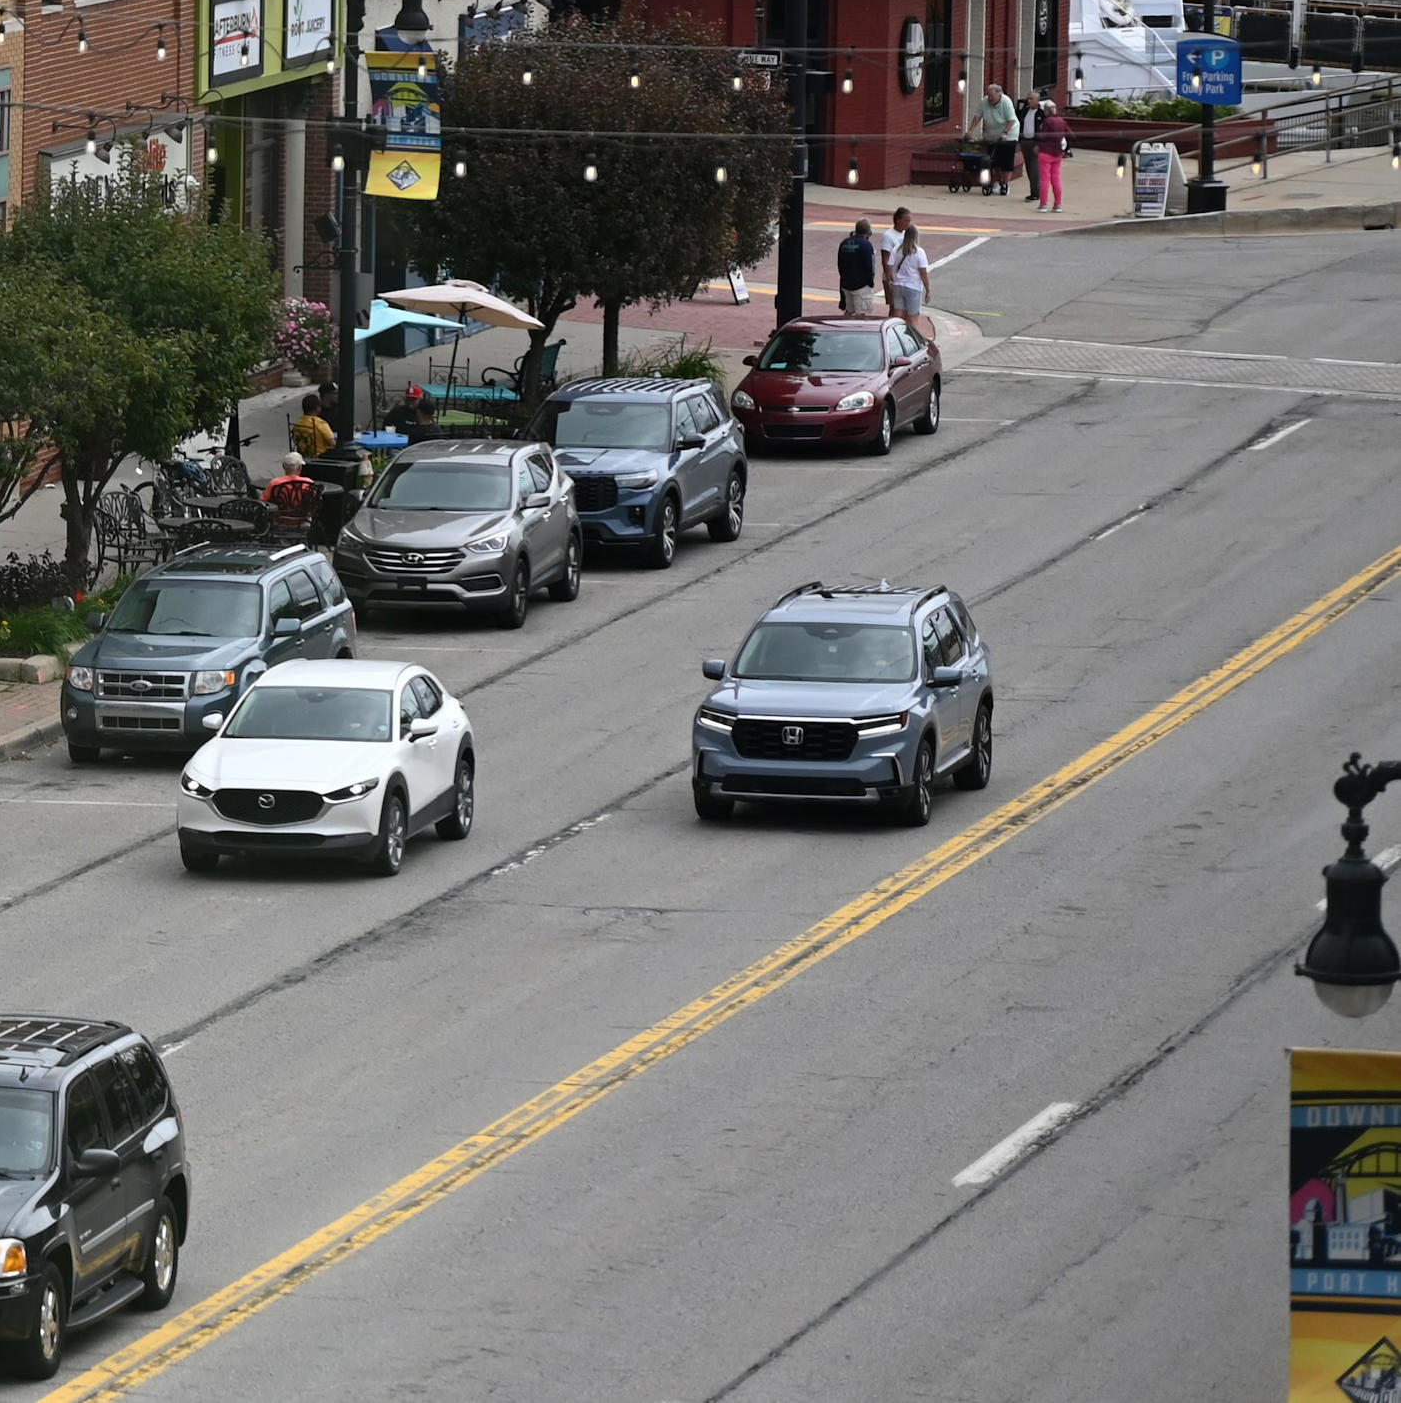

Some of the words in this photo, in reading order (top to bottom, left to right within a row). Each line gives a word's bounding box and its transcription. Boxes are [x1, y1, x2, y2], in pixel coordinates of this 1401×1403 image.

[214, 11, 251, 36] AFTERBURN
[760, 55, 776, 64] WAY
[1211, 50, 1225, 65] P
[1202, 71, 1235, 85] Parking
[1205, 84, 1225, 94] Park
[1307, 1273, 1366, 1293] PORT
